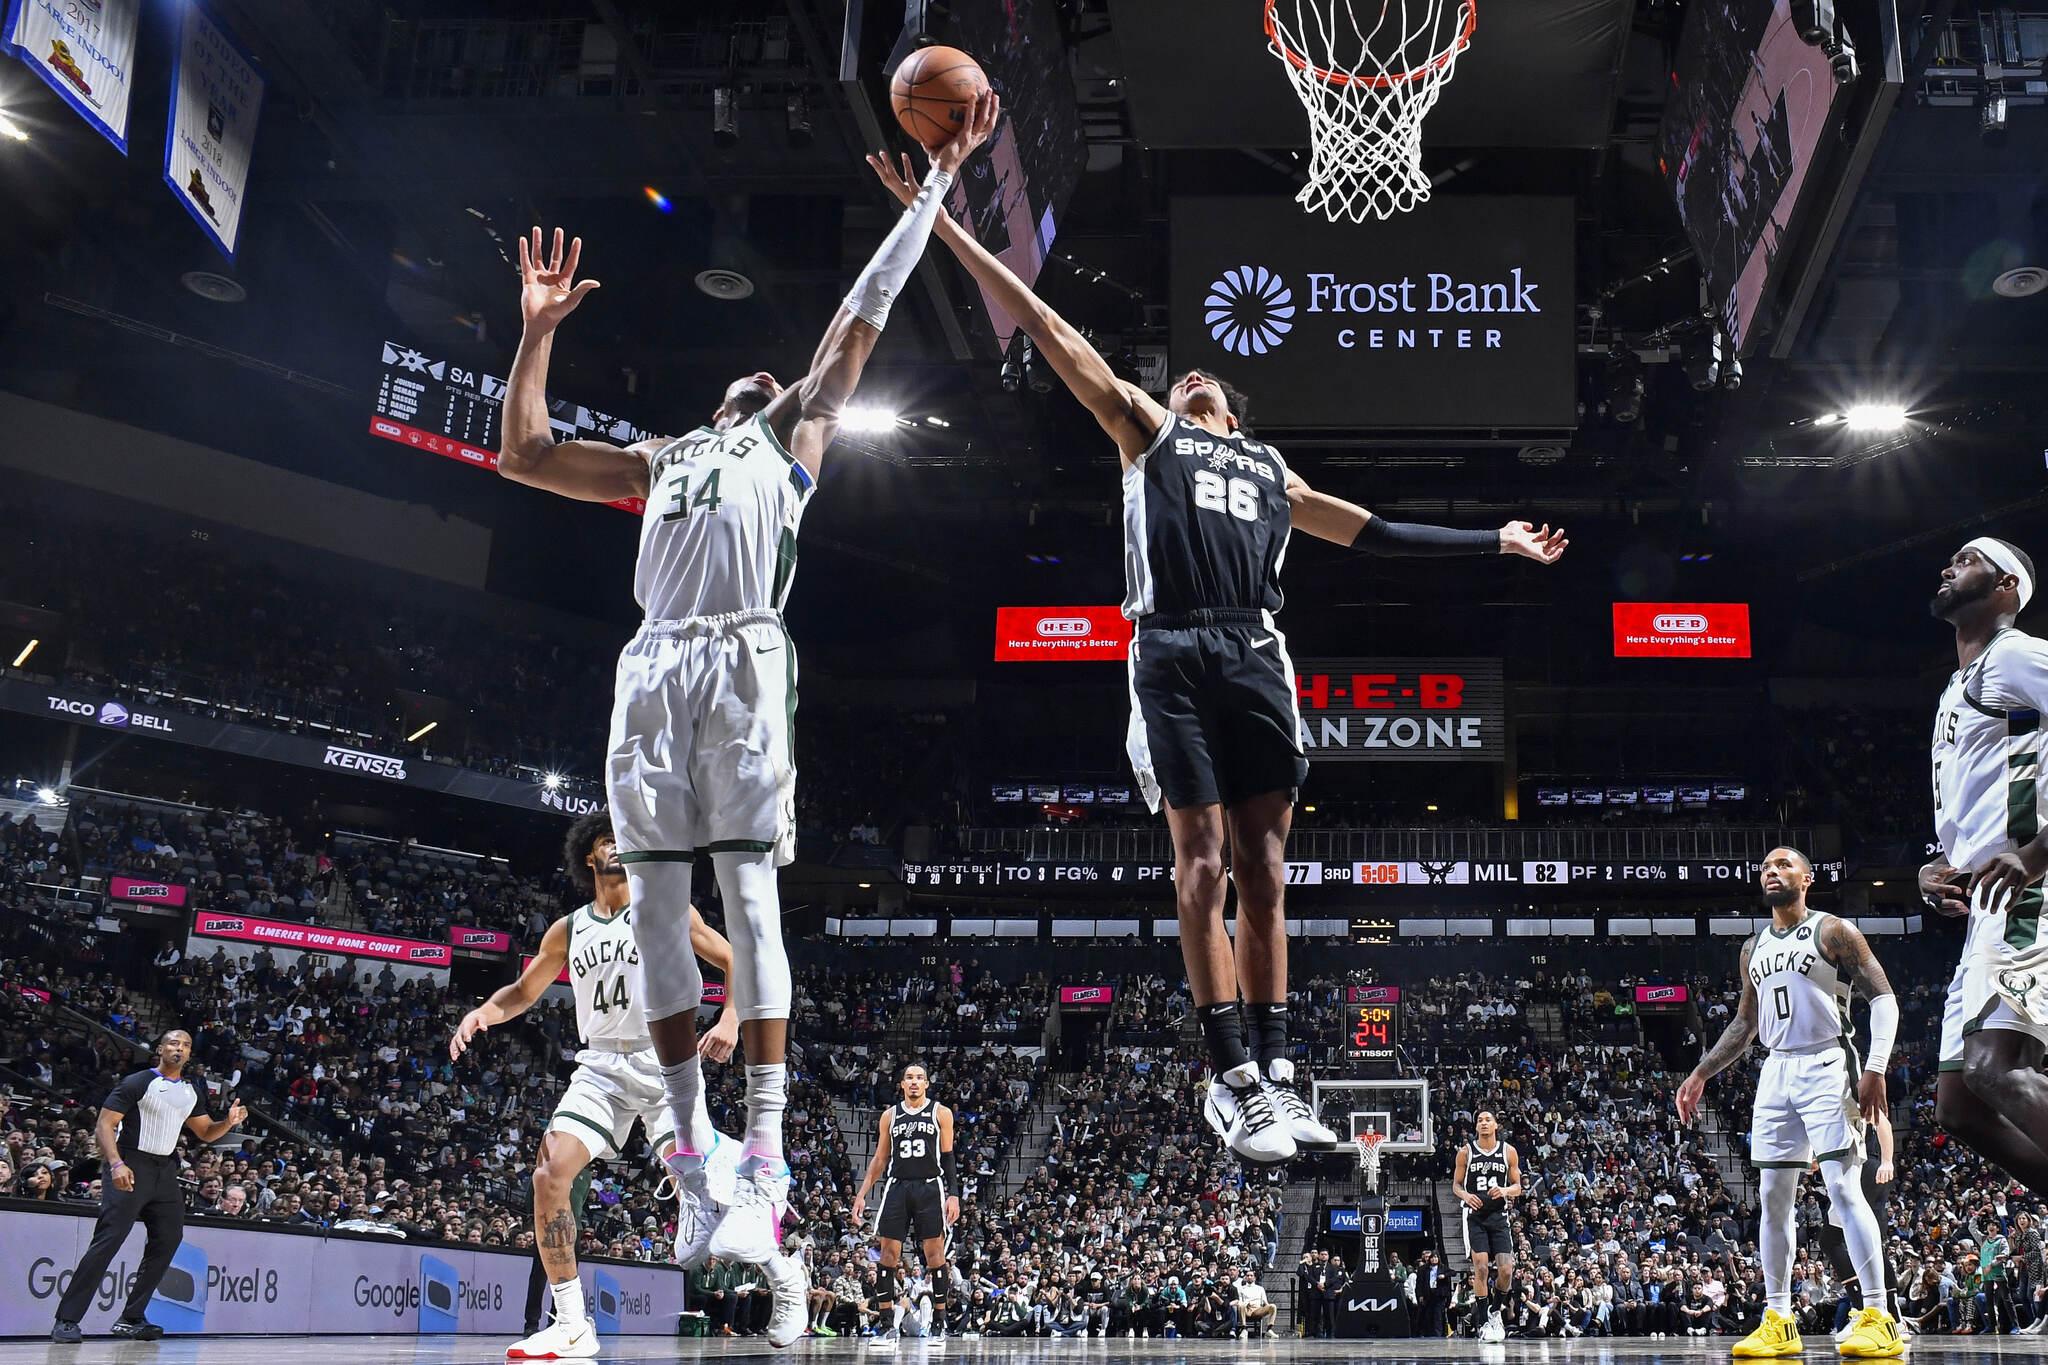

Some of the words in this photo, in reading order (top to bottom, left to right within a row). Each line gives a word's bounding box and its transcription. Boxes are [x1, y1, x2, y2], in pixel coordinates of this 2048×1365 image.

[37, 0, 75, 38] LARGE
[67, 2, 101, 39] 2017
[202, 134, 223, 167] 2018
[1306, 273, 1417, 313] Frost
[1427, 268, 1541, 313] Bank
[1337, 329, 1502, 348] CENTER
[394, 377, 426, 392] JOHNSON
[450, 367, 475, 388] SA
[392, 393, 418, 407] VASSELL
[654, 436, 759, 483] BUCKS
[663, 468, 722, 522] 34
[1194, 469, 1259, 521] 26
[191, 529, 209, 541] 212
[1008, 640, 1030, 648] Here
[1032, 639, 1087, 649] Everything's
[1089, 639, 1118, 647] Better
[1626, 636, 1648, 644] Here
[1650, 635, 1705, 645] Everything's
[1707, 636, 1736, 644] Better
[47, 696, 95, 716] TACO
[131, 713, 173, 732] BELL
[1300, 717, 1348, 748] AN
[1363, 717, 1482, 748] ZONE
[904, 864, 921, 873] REB
[925, 865, 946, 873] AST
[949, 865, 969, 873] STL
[971, 865, 993, 873] BLK
[1005, 866, 1031, 880] TO
[1038, 867, 1045, 881] 3
[1055, 866, 1098, 880] FG%
[1111, 867, 1124, 881] 47
[1138, 866, 1163, 880] PF
[1289, 865, 1310, 883] 77
[1324, 868, 1351, 880] 3RD
[1361, 865, 1399, 883] 5:05
[1475, 864, 1518, 881] MIL
[1535, 864, 1557, 882] 82
[1572, 866, 1597, 879] PF
[1605, 866, 1613, 880] 2
[1623, 866, 1666, 879] FG%
[1678, 866, 1689, 880] 51
[1703, 866, 1730, 879] TO
[1735, 866, 1742, 880] 4
[1823, 862, 1842, 871] REB
[1831, 870, 1838, 882] 31
[907, 873, 916, 884] 29
[930, 873, 940, 884] 20
[979, 873, 984, 884] 5
[253, 926, 303, 940] ELMERIZE
[307, 933, 335, 945] YOUR
[337, 936, 366, 949] HOME
[369, 941, 402, 953] COURT
[307, 955, 327, 967] 111
[573, 939, 639, 978] BUCKS
[920, 956, 936, 965] 113
[1530, 955, 1546, 964] 115
[1750, 950, 1817, 986] BUCKS
[593, 975, 629, 1014] 44
[1773, 985, 1790, 1021] 0
[1361, 1008, 1390, 1022] 5:04
[1355, 1022, 1387, 1047] 24
[893, 1121, 935, 1138] SPURS
[900, 1139, 926, 1159] 33
[1477, 1176, 1499, 1190] 24
[1388, 1216, 1418, 1228] apital
[1365, 1236, 1379, 1248] GET
[1365, 1249, 1379, 1260] THE
[1364, 1261, 1379, 1273] APP
[28, 1257, 138, 1312] Gogle
[207, 1265, 259, 1302] Pixel
[264, 1269, 278, 1303] 8
[354, 1274, 420, 1317] Google
[457, 1280, 491, 1312] Pixel
[493, 1284, 503, 1312] 8
[619, 1290, 641, 1315] Pixel
[643, 1293, 651, 1315] 8
